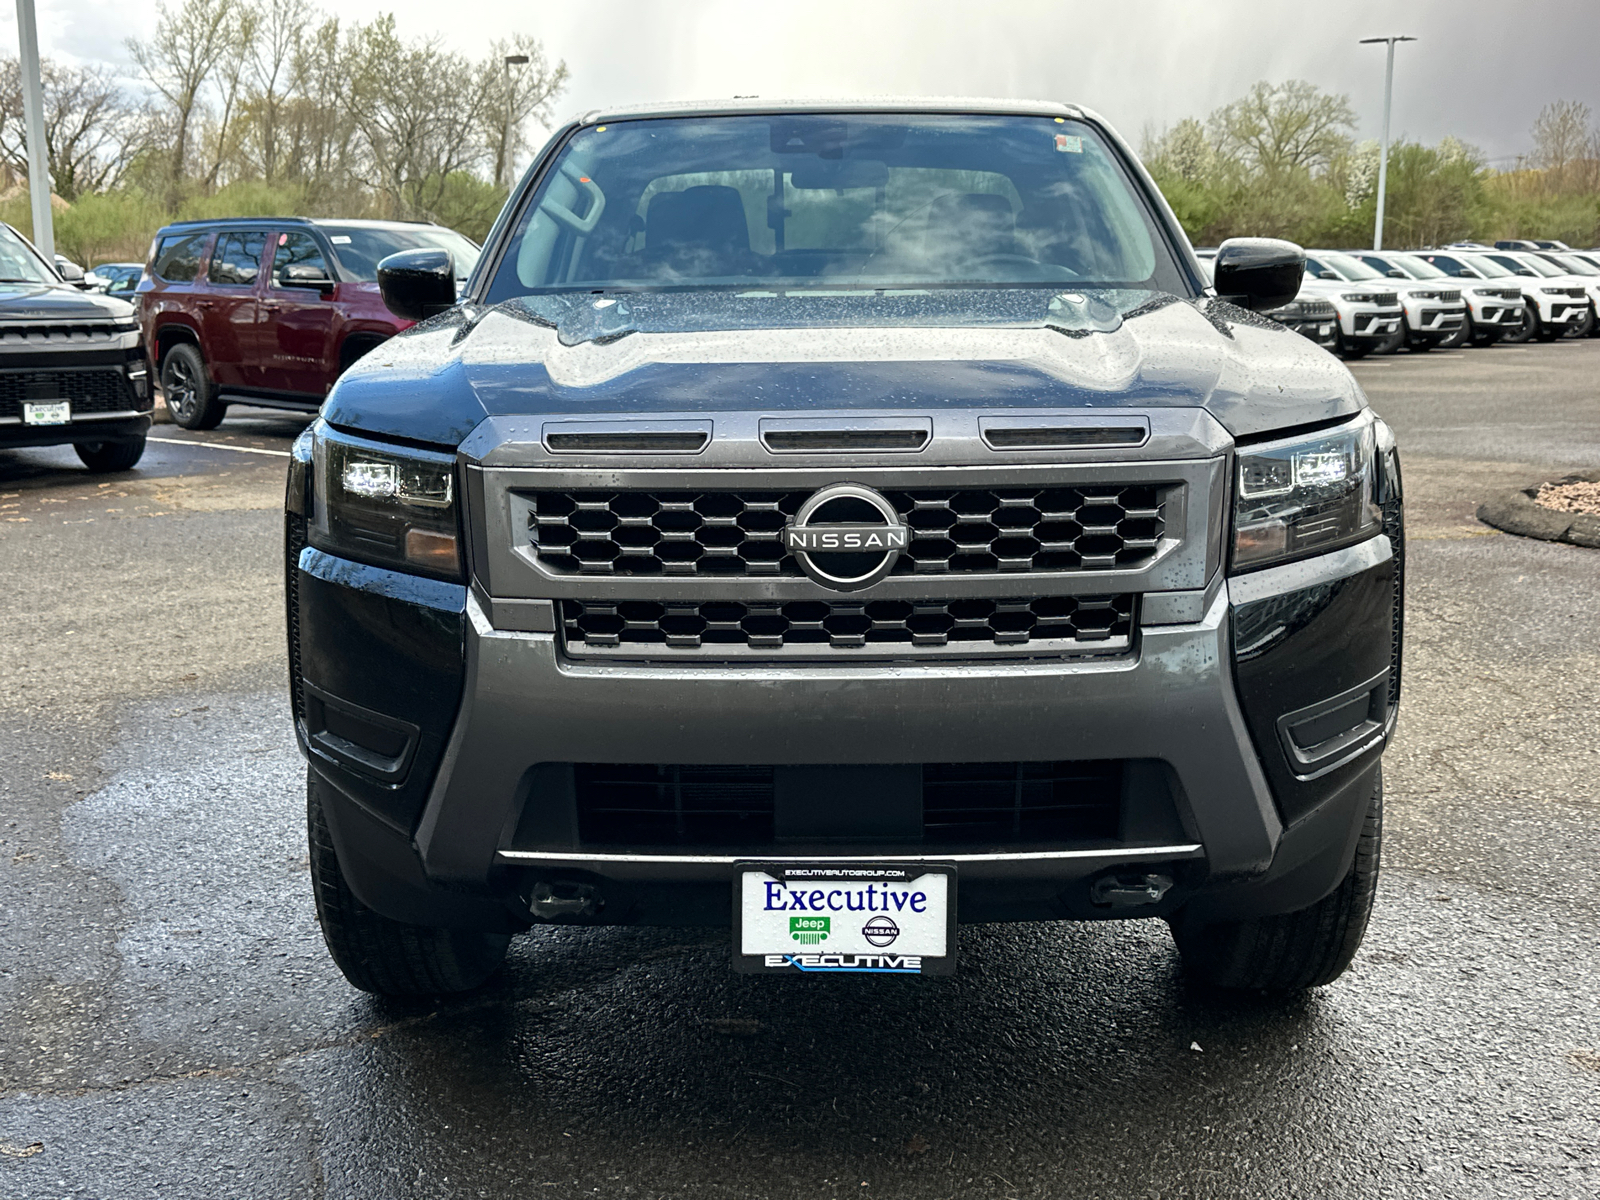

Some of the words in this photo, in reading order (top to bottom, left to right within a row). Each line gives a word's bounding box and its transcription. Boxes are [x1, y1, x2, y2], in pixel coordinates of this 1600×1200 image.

[789, 531, 905, 548] NISSAN
[784, 869, 905, 877] EXECUTIVEAUTOGROUP.COM
[763, 881, 927, 913] Executive
[795, 918, 825, 930] Jeep
[764, 955, 922, 970] EXECUTIVE
